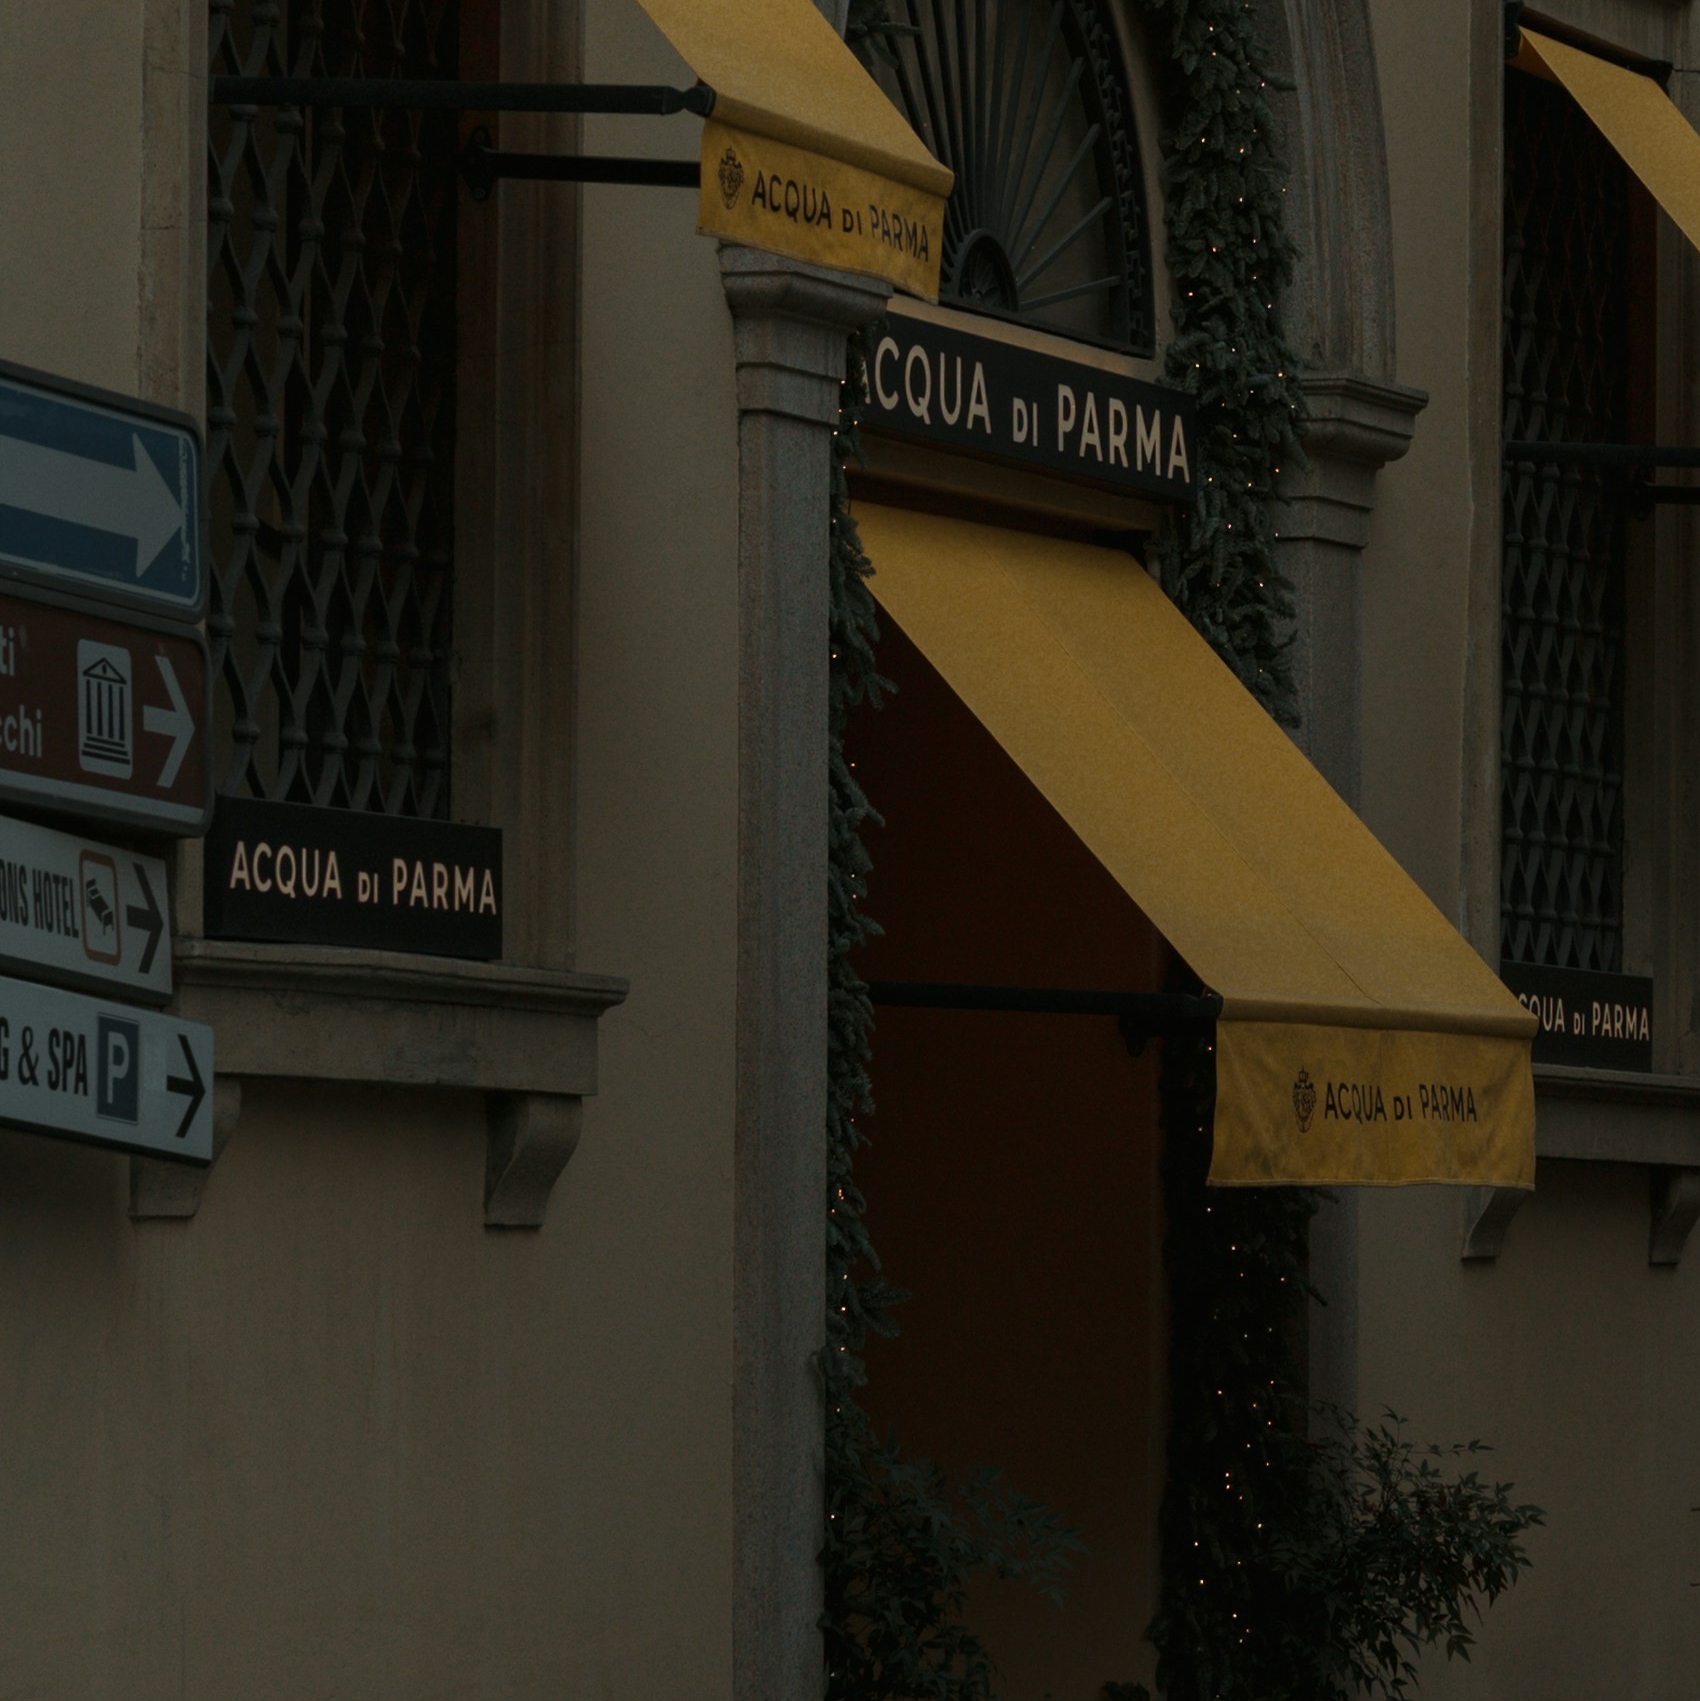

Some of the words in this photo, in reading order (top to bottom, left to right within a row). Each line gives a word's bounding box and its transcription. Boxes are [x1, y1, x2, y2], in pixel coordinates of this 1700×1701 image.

[752, 169, 832, 230] ACQUA
[869, 203, 929, 263] PARMA
[1012, 396, 1038, 448] DI
[1058, 383, 1191, 484] PARMA
[0, 704, 42, 759] chi
[32, 868, 79, 938] HOTEL
[229, 840, 343, 900] ACQUA
[357, 870, 379, 904] DI
[392, 857, 497, 916] PARMA
[1592, 1001, 1650, 1042] PARMA
[18, 1026, 39, 1086] &
[47, 1027, 88, 1097] SPA
[1324, 1082, 1388, 1125] ACQUA
[1419, 1084, 1477, 1123] PARMA
